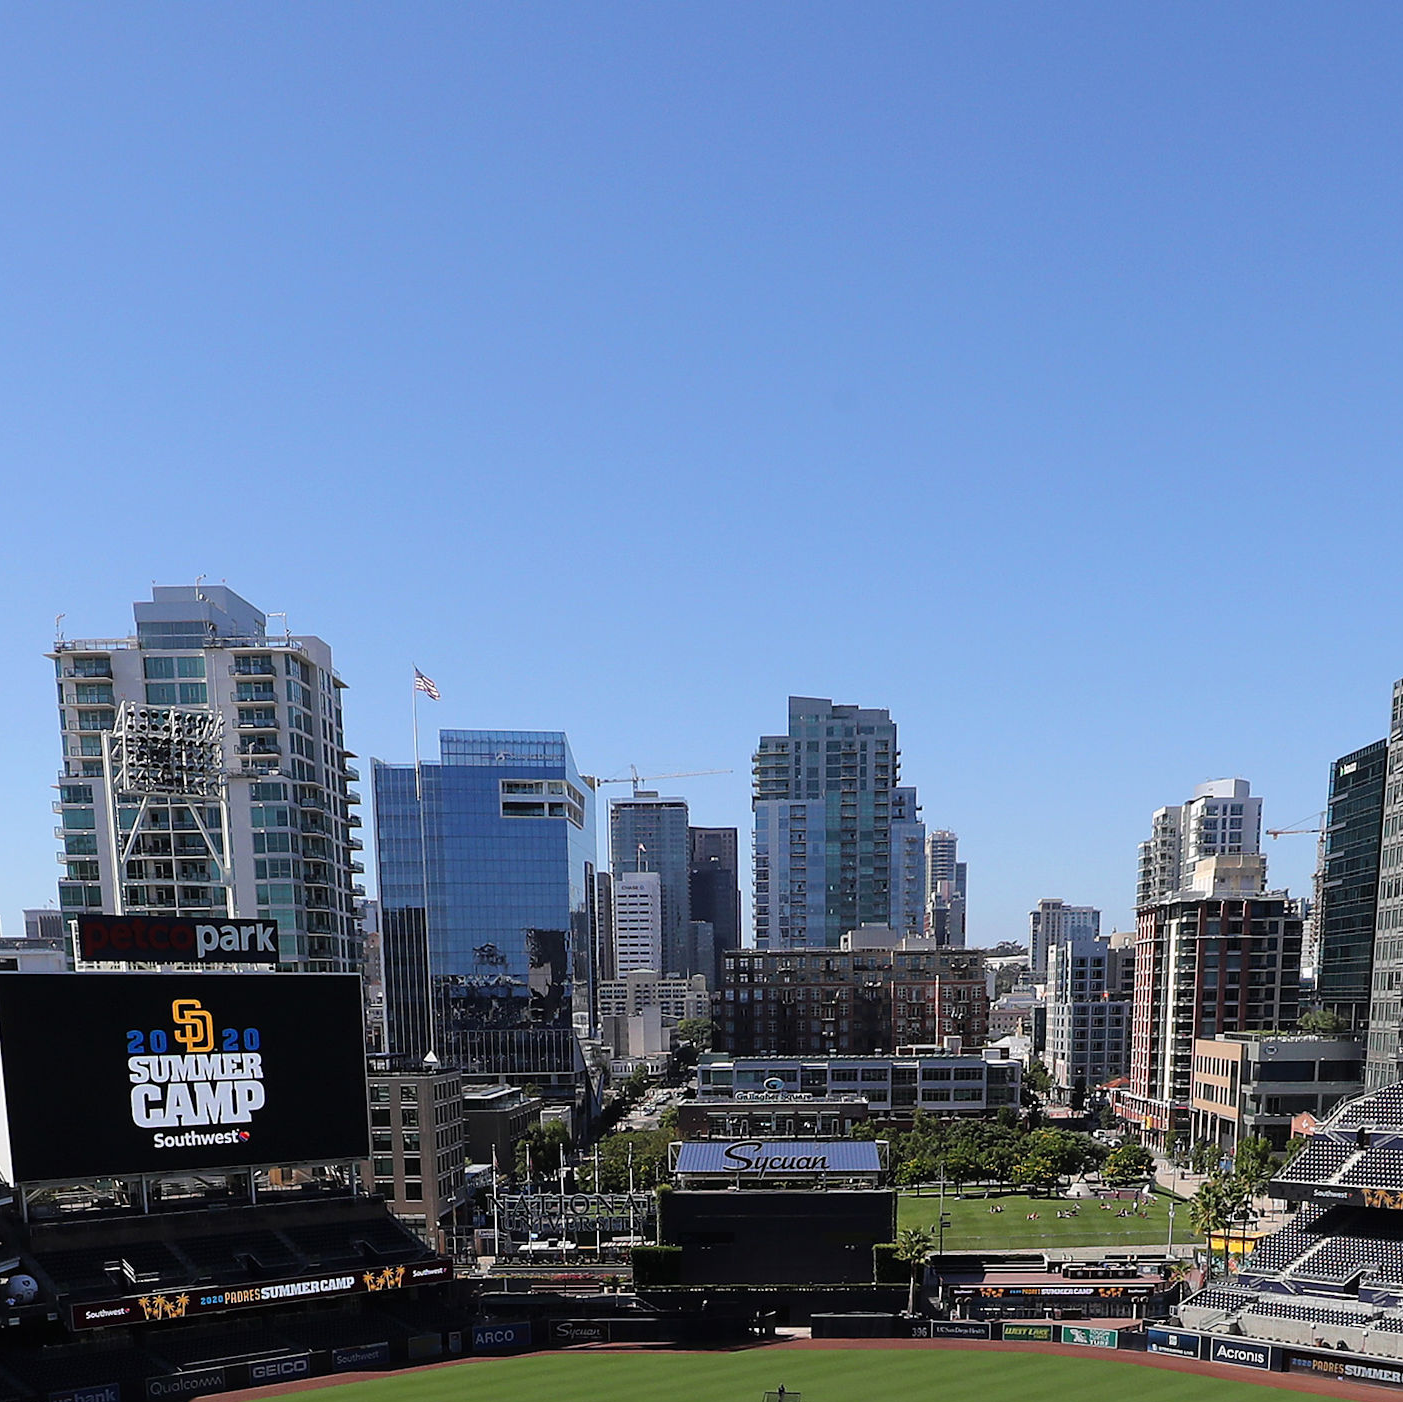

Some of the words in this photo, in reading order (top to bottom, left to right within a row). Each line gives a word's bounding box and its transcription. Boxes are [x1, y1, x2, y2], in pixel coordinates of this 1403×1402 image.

[84, 918, 195, 957] petco
[195, 922, 277, 959] park
[172, 999, 216, 1053] SD
[128, 1053, 264, 1084] SUMMER
[130, 1081, 265, 1128] CAMP
[735, 1091, 779, 1103] Gallagher
[780, 1091, 813, 1103] Square
[153, 1130, 240, 1148] Southwest
[722, 1141, 830, 1180] Sycuan
[1313, 1188, 1348, 1199] Southwest
[412, 1267, 443, 1278] Southwest
[200, 1295, 224, 1305] 2020
[224, 1288, 261, 1304] PADRES
[260, 1281, 320, 1300] SUMMER
[319, 1276, 355, 1293] CAMP
[85, 1307, 125, 1319] Southwest
[475, 1329, 515, 1345] ARCO
[557, 1322, 602, 1342] Sycuan
[911, 1326, 928, 1337] 396
[336, 1350, 379, 1366] Southwest
[1217, 1345, 1265, 1364] Acronis
[251, 1360, 308, 1380] GEICO
[1291, 1357, 1312, 1368] 2020
[1312, 1359, 1344, 1375] PADRES
[1344, 1364, 1401, 1382] SUMMER
[149, 1376, 223, 1397] Qualcomm
